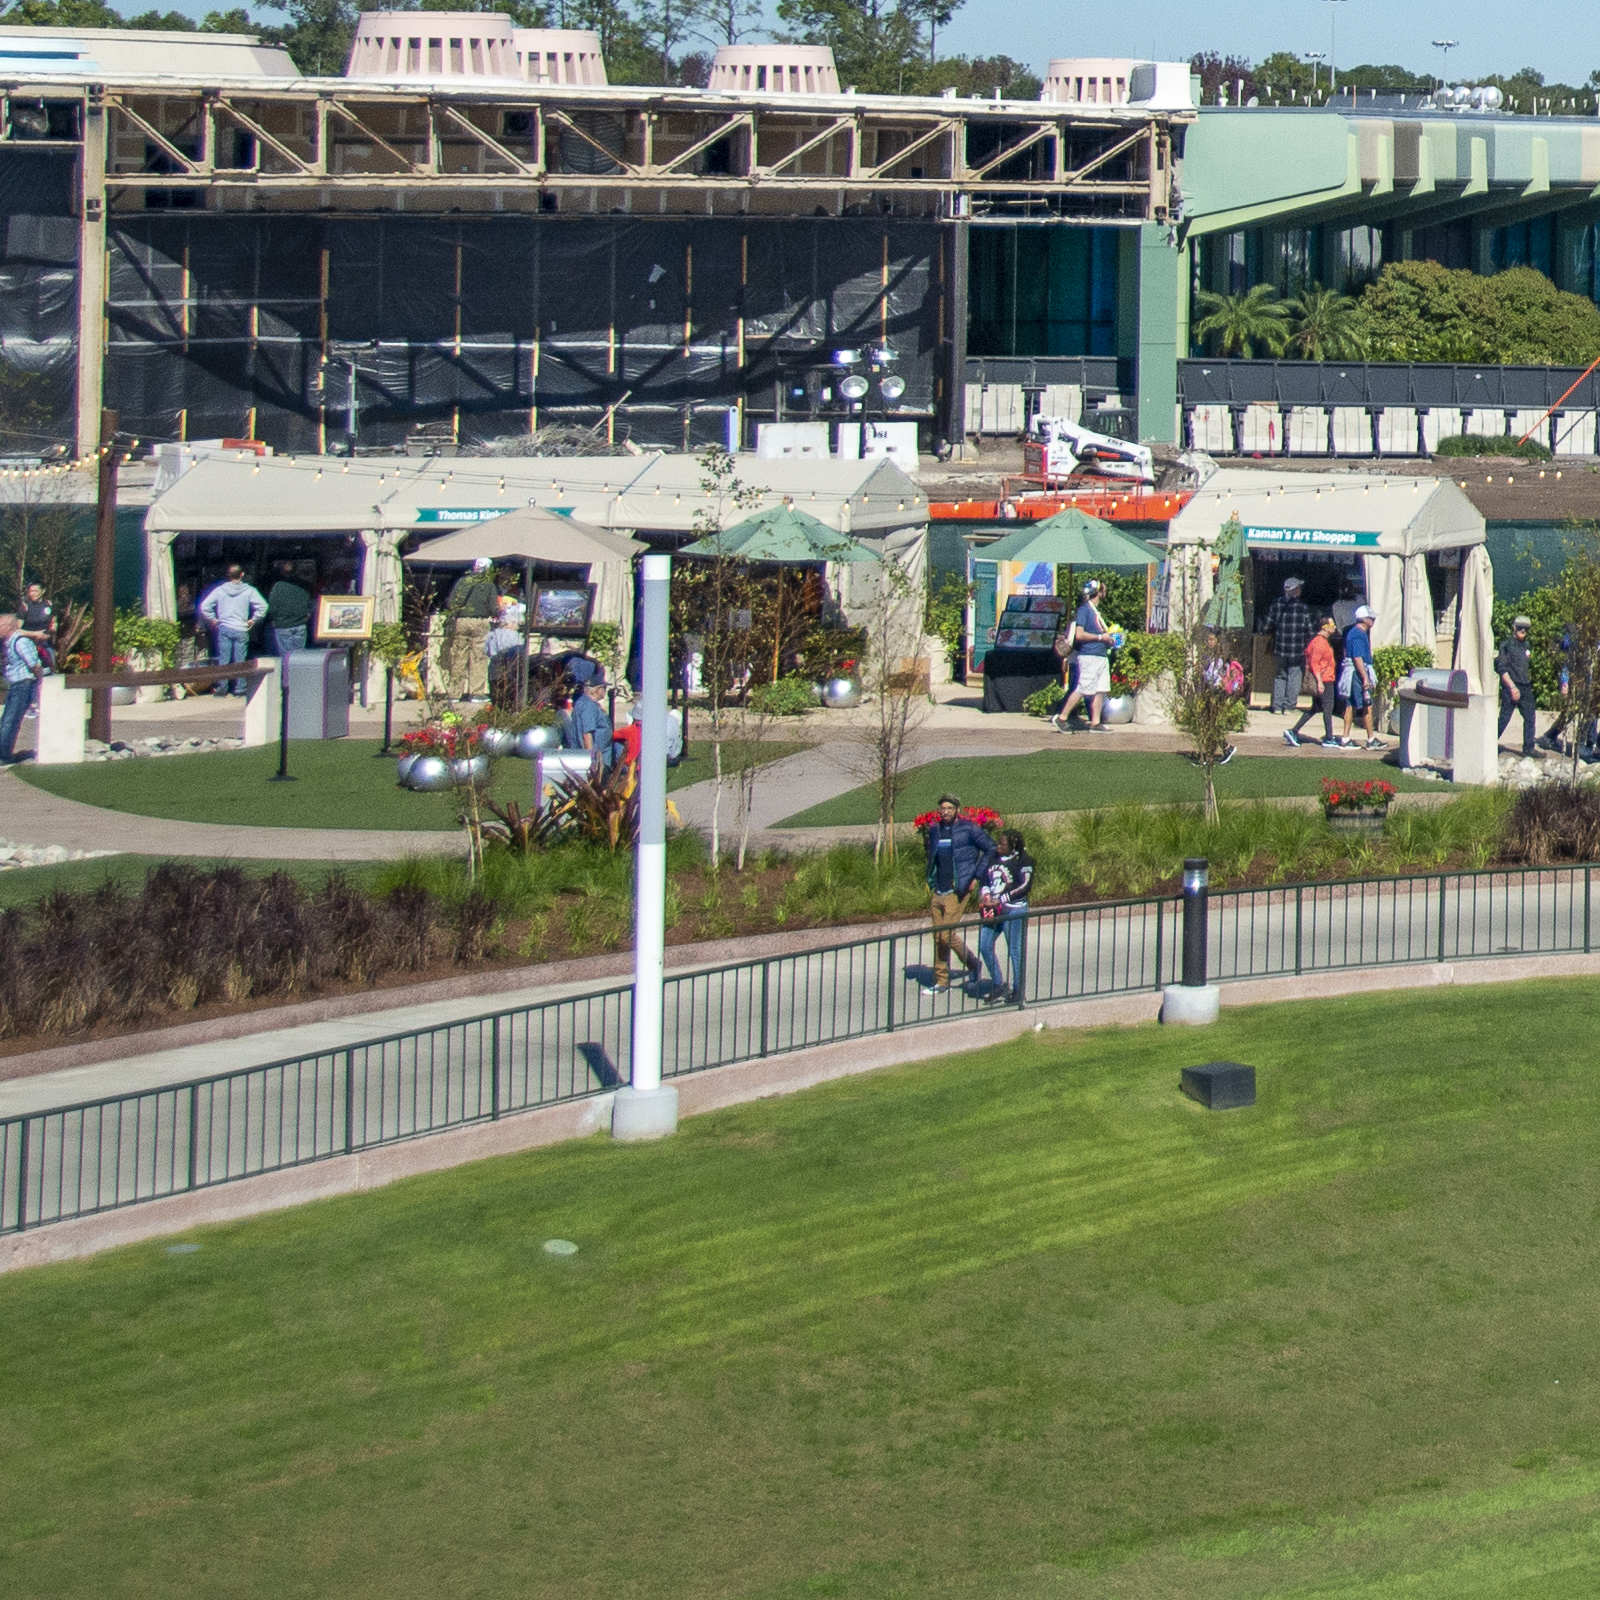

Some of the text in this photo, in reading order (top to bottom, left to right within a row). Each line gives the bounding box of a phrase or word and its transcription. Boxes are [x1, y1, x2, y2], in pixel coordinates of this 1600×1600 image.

[438, 510, 506, 520] Thomas Kink
[1247, 528, 1357, 544] Kaman's Art Shoppes
